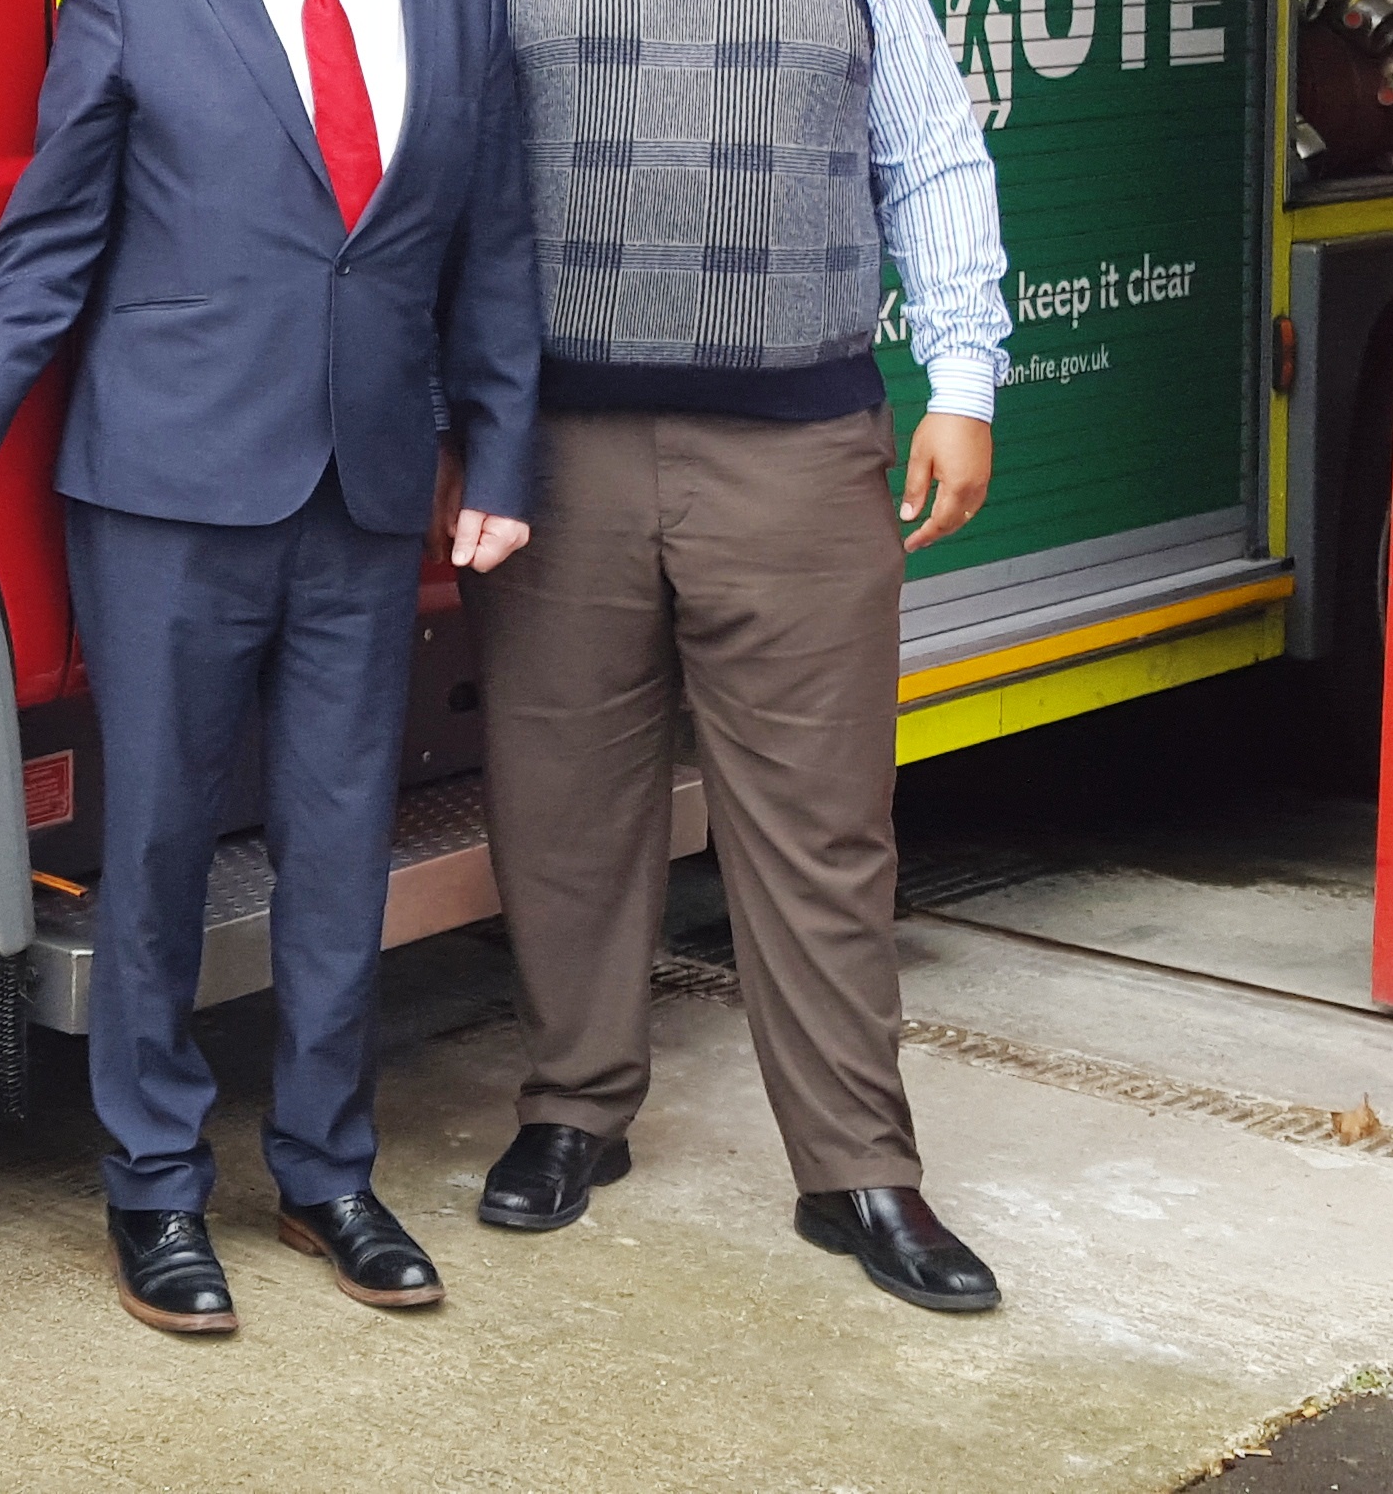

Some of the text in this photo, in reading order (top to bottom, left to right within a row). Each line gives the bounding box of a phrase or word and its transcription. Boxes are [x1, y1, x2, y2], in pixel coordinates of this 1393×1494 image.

[1018, 253, 1196, 329] keep it clear
